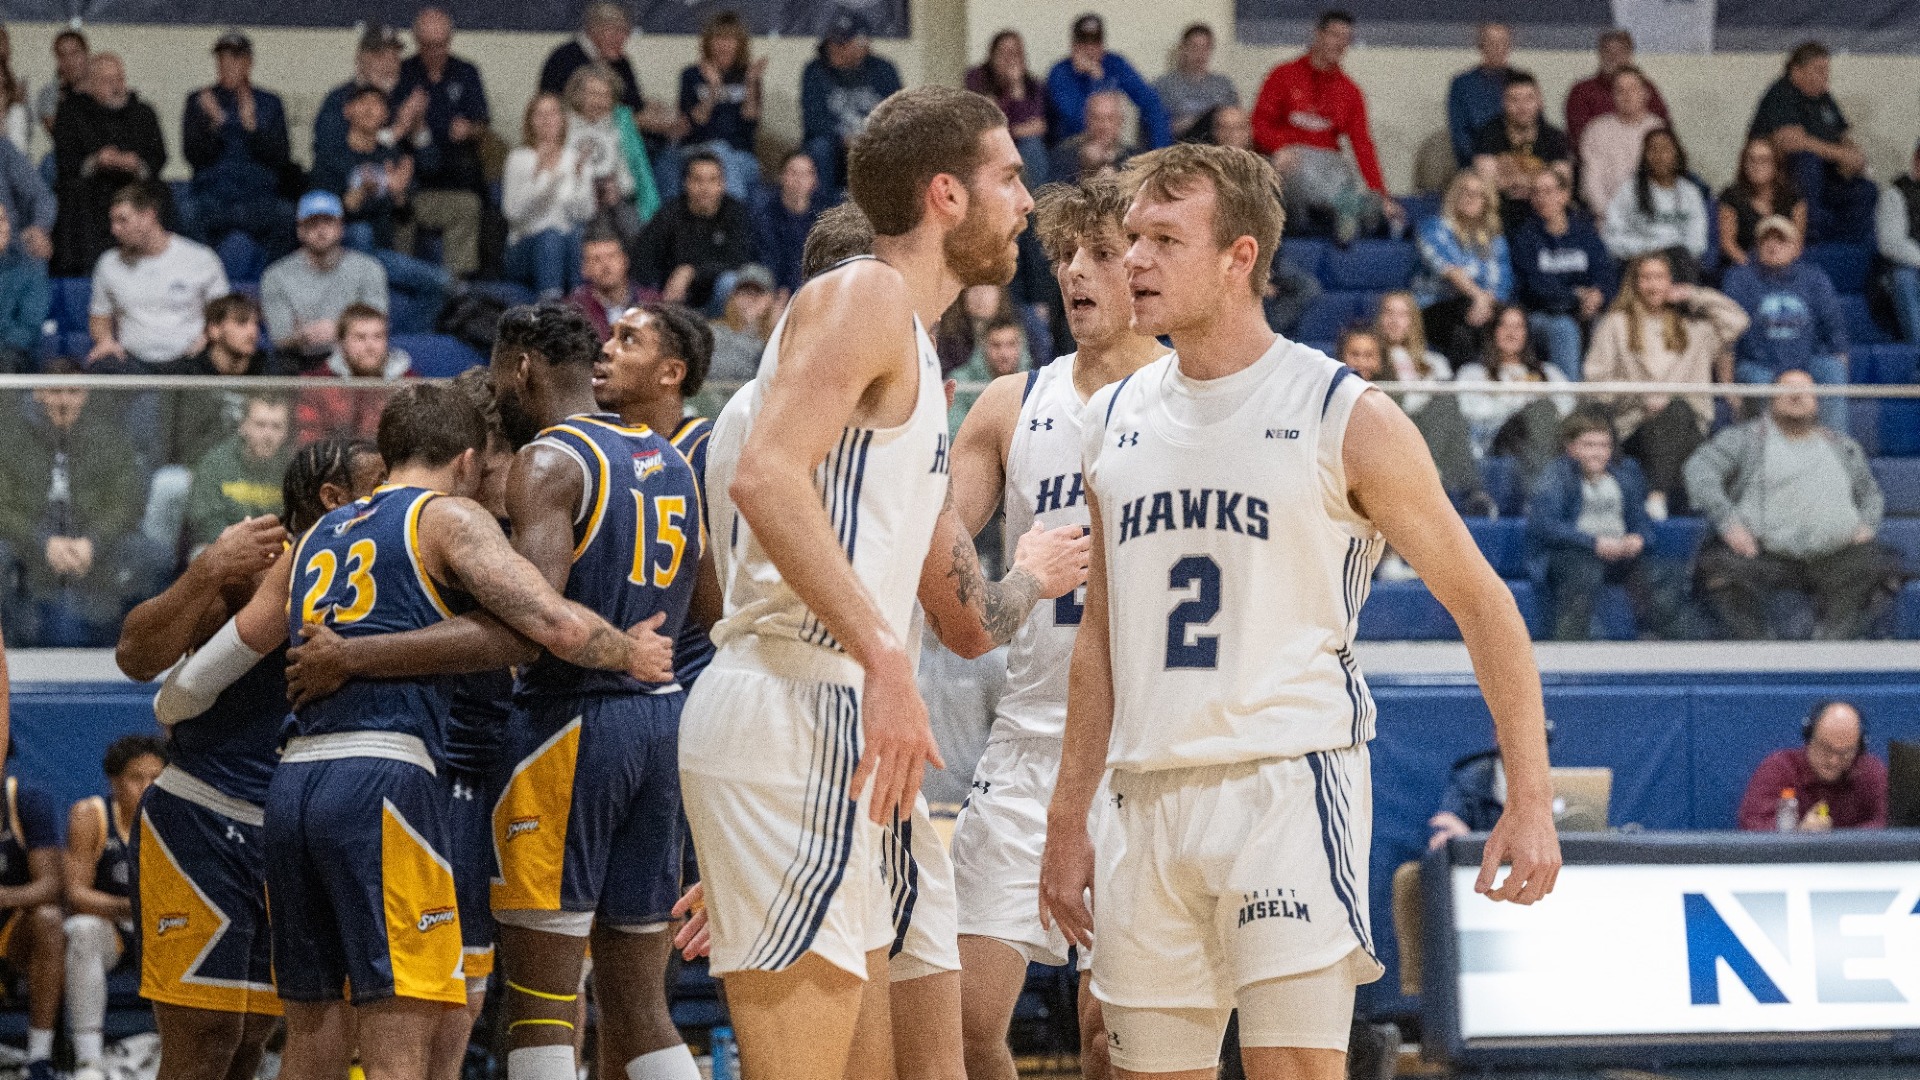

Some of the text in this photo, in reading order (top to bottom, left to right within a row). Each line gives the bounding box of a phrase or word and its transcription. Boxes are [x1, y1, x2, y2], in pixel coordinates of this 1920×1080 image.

[1265, 429, 1300, 440] NE10
[627, 487, 688, 589] 15
[1118, 487, 1270, 546] HAWKS
[302, 537, 378, 624] 23
[1163, 552, 1223, 671] 2
[416, 910, 455, 931] SNHU
[1237, 899, 1312, 929] ANSELM
[1243, 888, 1296, 903] SAINT
[1682, 890, 1920, 1005] NE
